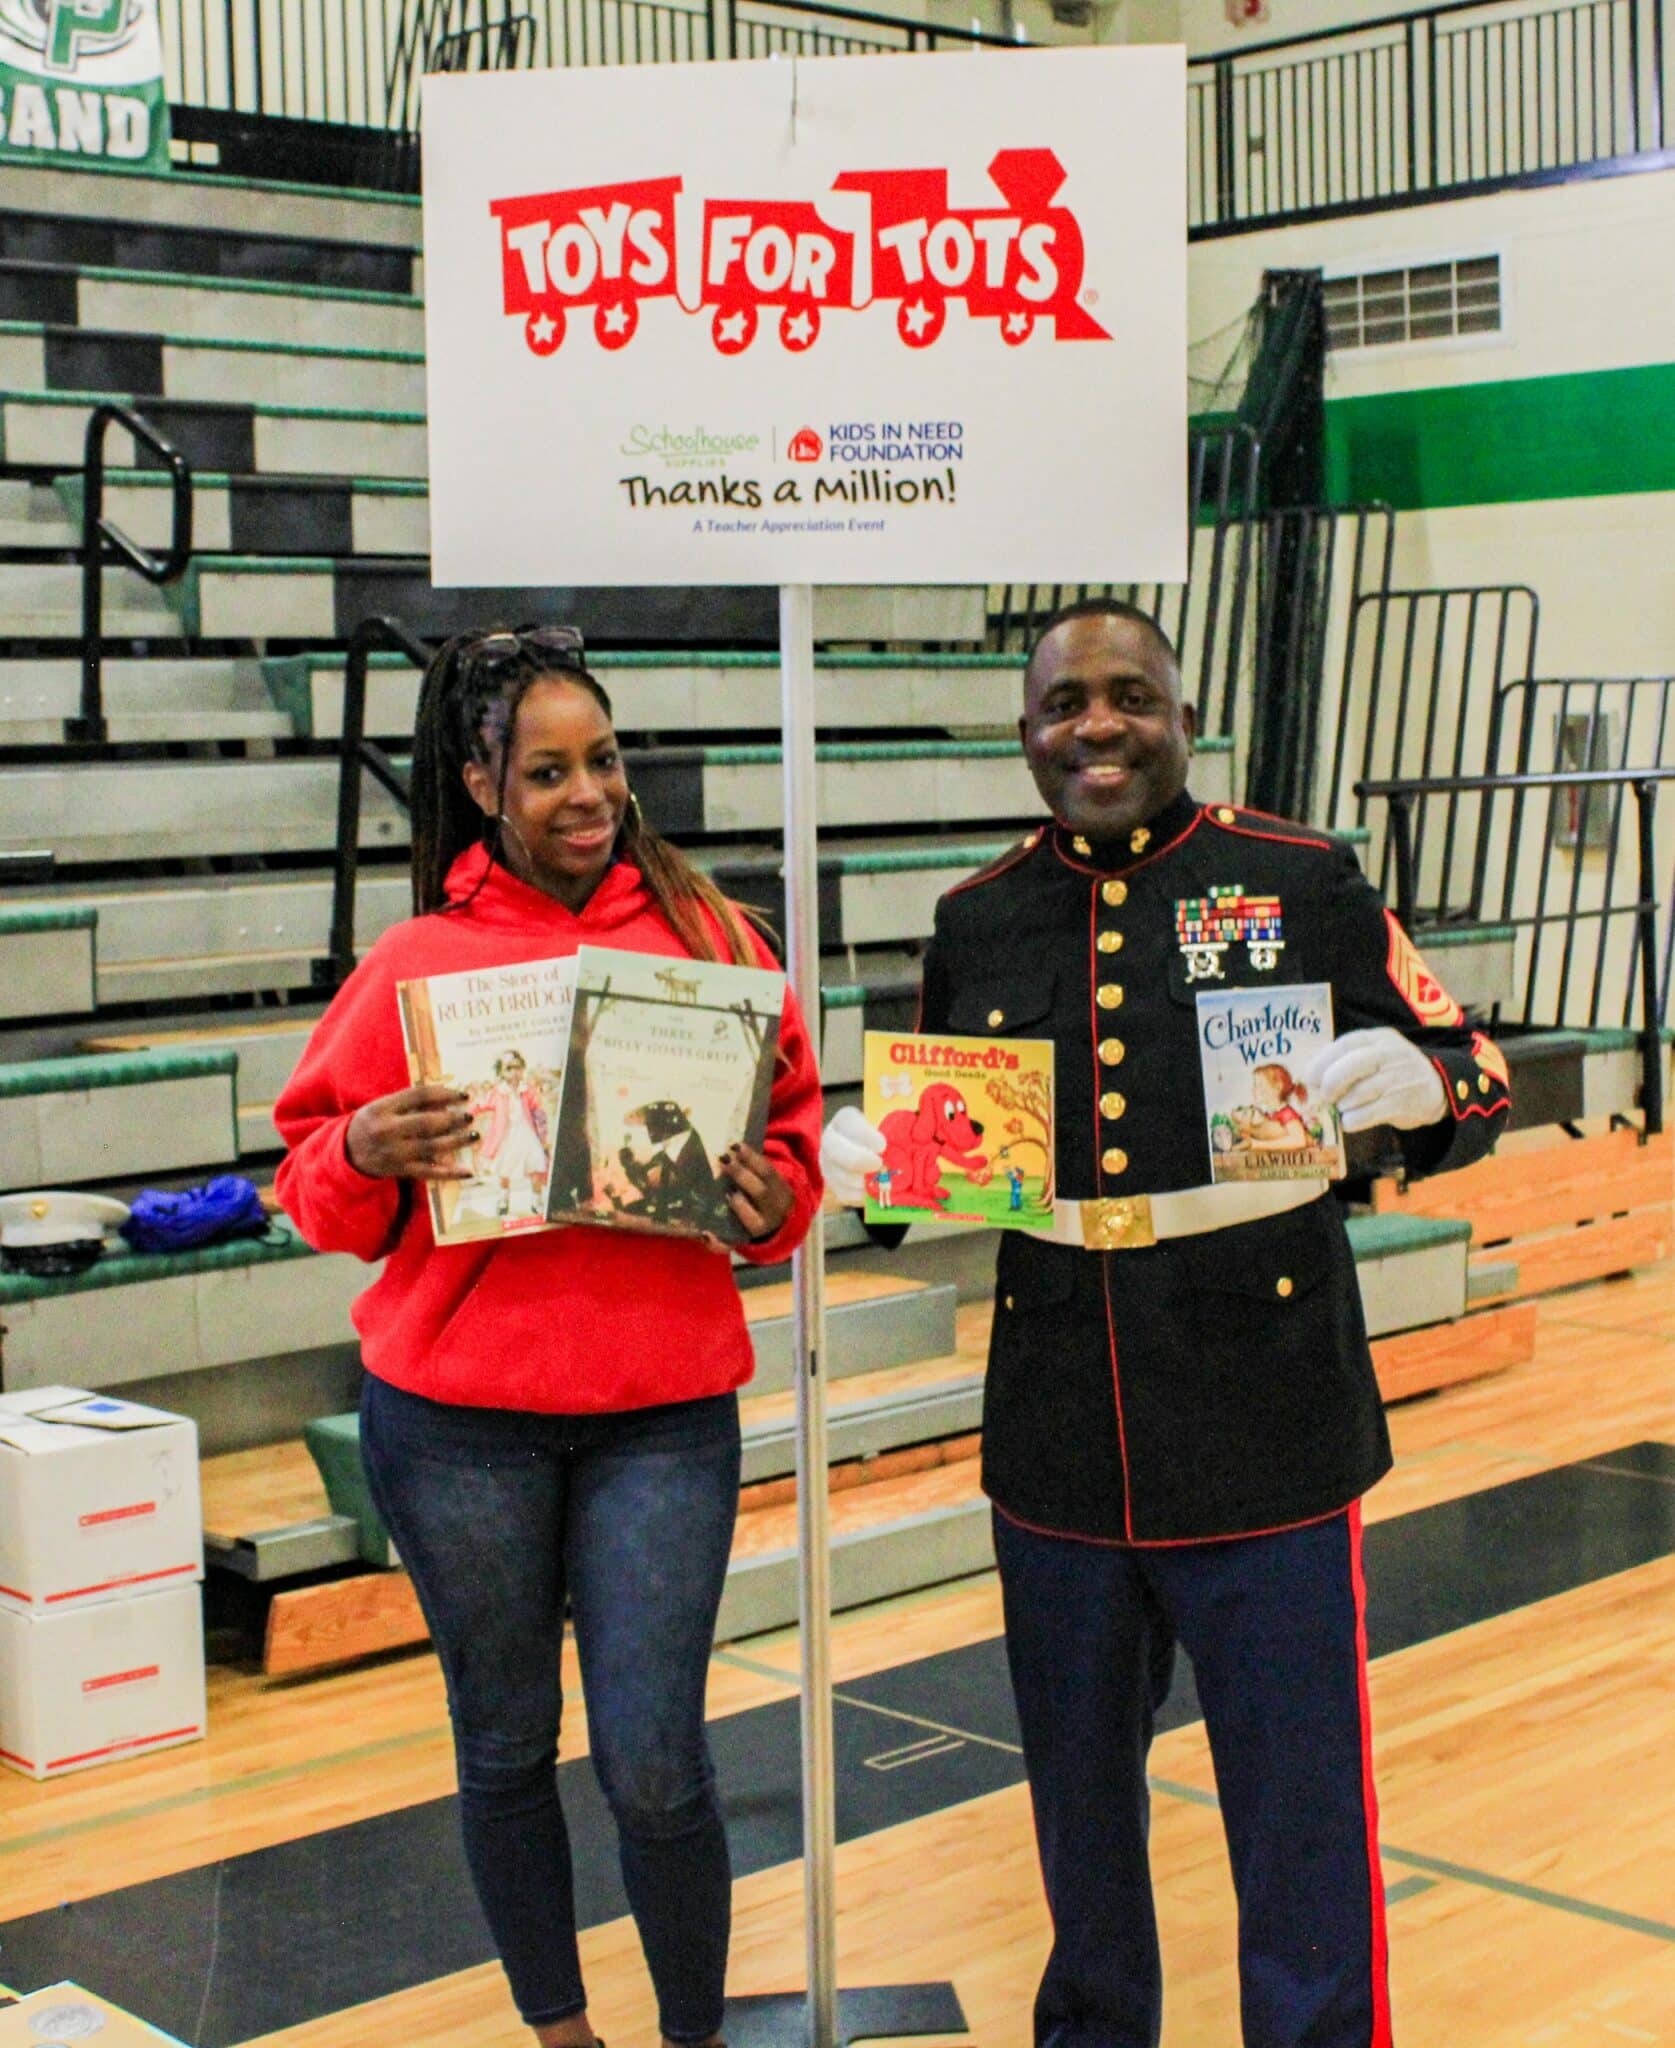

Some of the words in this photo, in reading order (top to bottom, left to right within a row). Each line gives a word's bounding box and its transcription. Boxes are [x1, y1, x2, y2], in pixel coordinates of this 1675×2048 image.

[0, 83, 149, 159] AND
[508, 202, 669, 296] TOYS
[708, 215, 836, 298] FOR
[879, 218, 1058, 301] TOTS
[620, 423, 760, 456] Schoolhouse
[829, 423, 876, 441] KIDS
[882, 423, 902, 440] IN
[908, 422, 963, 440] NEED
[829, 443, 963, 462] FOUNDATION
[619, 474, 762, 508] Thanks
[774, 479, 802, 502] a
[814, 467, 957, 505] Million!
[693, 519, 704, 532] A
[708, 519, 756, 533] Teacher
[761, 519, 844, 535] Appreciation
[848, 518, 885, 532] Event
[463, 975, 494, 993] The
[498, 971, 538, 991] Story
[543, 964, 559, 982] of
[437, 998, 493, 1023] RUBY
[497, 985, 574, 1014] BRIDGE
[1204, 1001, 1321, 1050] Charlotte's
[890, 1042, 1019, 1070] Clifford's
[1239, 1031, 1292, 1065] Web
